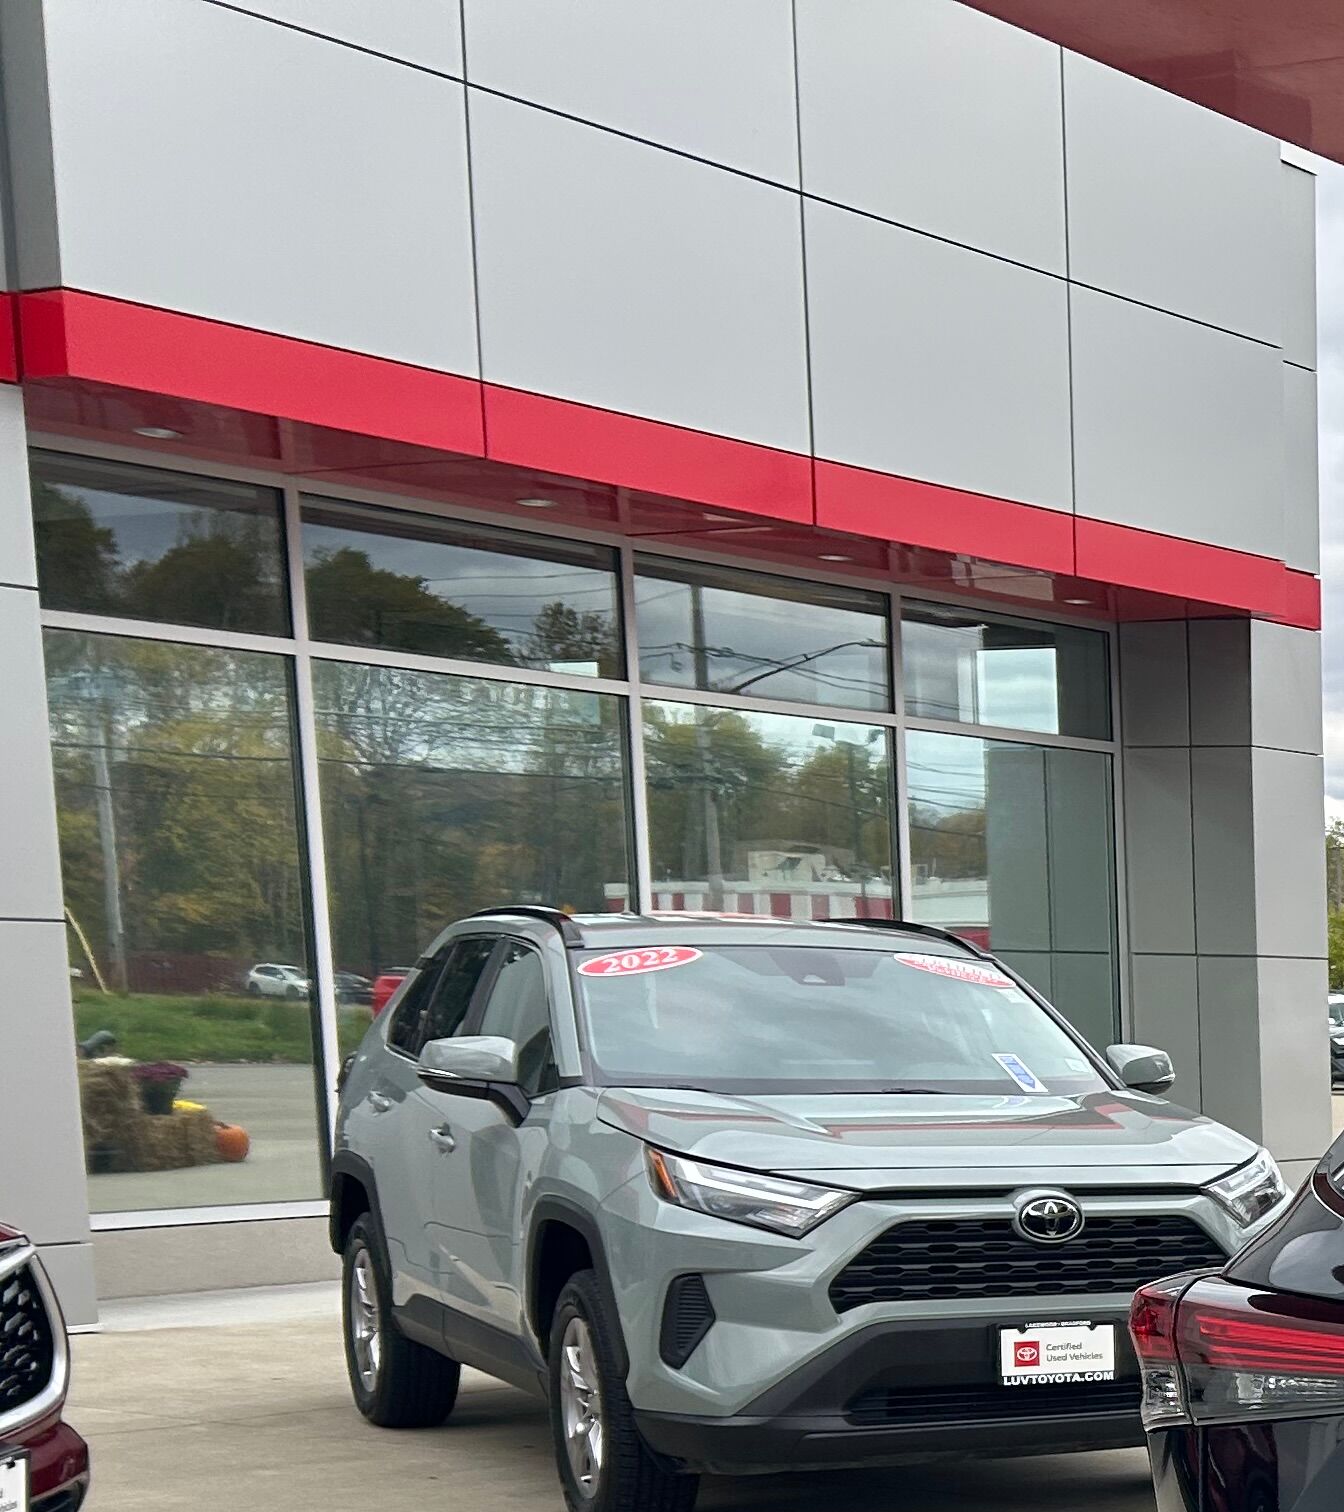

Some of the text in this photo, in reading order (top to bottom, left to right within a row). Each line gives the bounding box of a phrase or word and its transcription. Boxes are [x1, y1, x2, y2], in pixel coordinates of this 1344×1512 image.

[602, 948, 678, 973] 2022
[1046, 1342, 1082, 1351] Certified
[1069, 1352, 1103, 1361] Vehicles
[1003, 1371, 1114, 1386] LUVTOYOTA.COM
